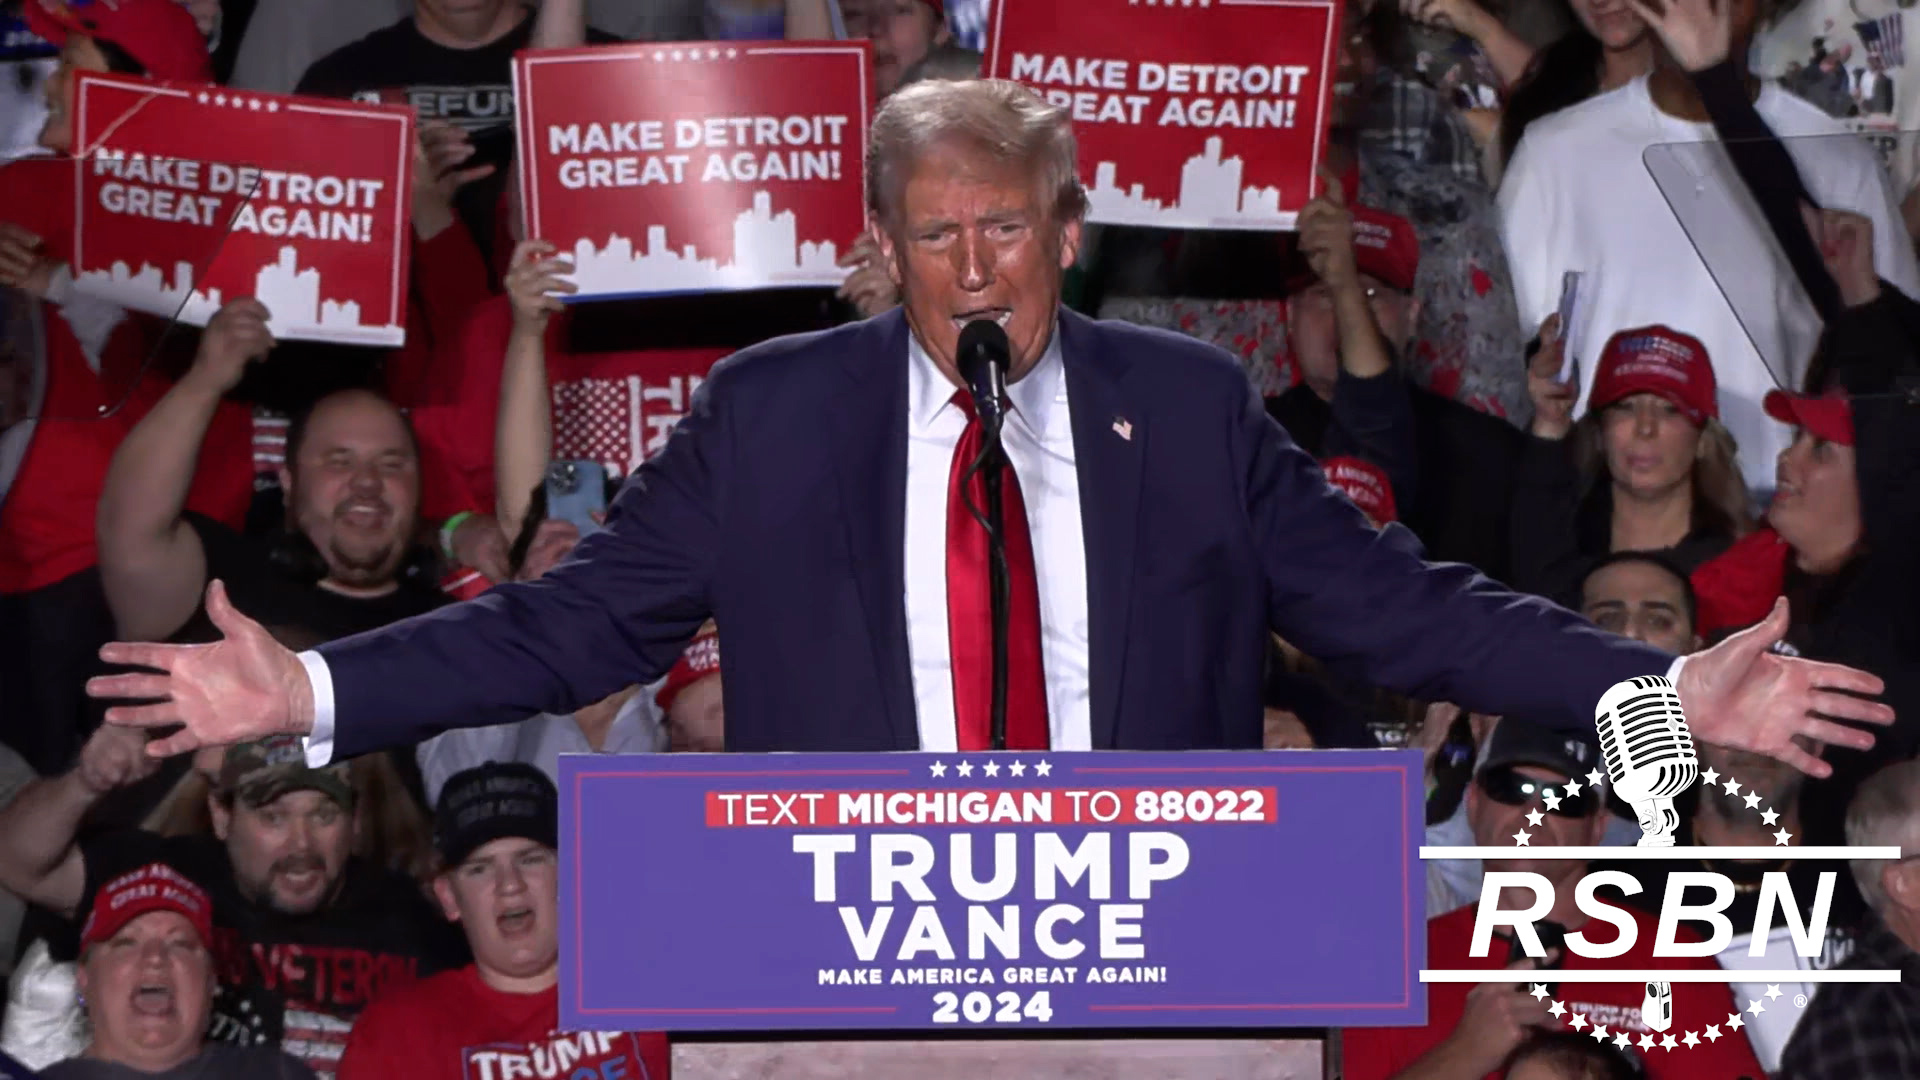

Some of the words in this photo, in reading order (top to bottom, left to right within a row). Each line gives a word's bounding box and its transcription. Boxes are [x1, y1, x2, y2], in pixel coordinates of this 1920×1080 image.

[1010, 52, 1129, 90] MAKE
[1138, 62, 1309, 95] DETROIT
[1030, 87, 1151, 124] REAT
[1157, 97, 1297, 128] AGAIN!
[548, 120, 664, 155] MAKE
[675, 115, 848, 149] DETROIT
[93, 146, 200, 190] MAKE
[208, 162, 384, 209] DETROIT
[558, 153, 690, 189] GREAT
[701, 151, 842, 182] AGAIN!
[100, 181, 222, 227] GREAT
[229, 200, 373, 243] AGAIN!
[718, 793, 825, 825] TEXT
[838, 791, 1052, 824] MICHIGAN
[1065, 791, 1122, 822] TO
[1134, 790, 1265, 822] 88022
[792, 831, 1190, 902] TRUMP
[838, 904, 1145, 961] VANCE
[818, 968, 883, 985] MAKE
[890, 967, 995, 985] AMERICA
[1003, 967, 1078, 984] GREAT
[1086, 966, 1167, 984] AGAIN!
[932, 990, 1053, 1024] 2024
[470, 1030, 623, 1080] TRUMP
